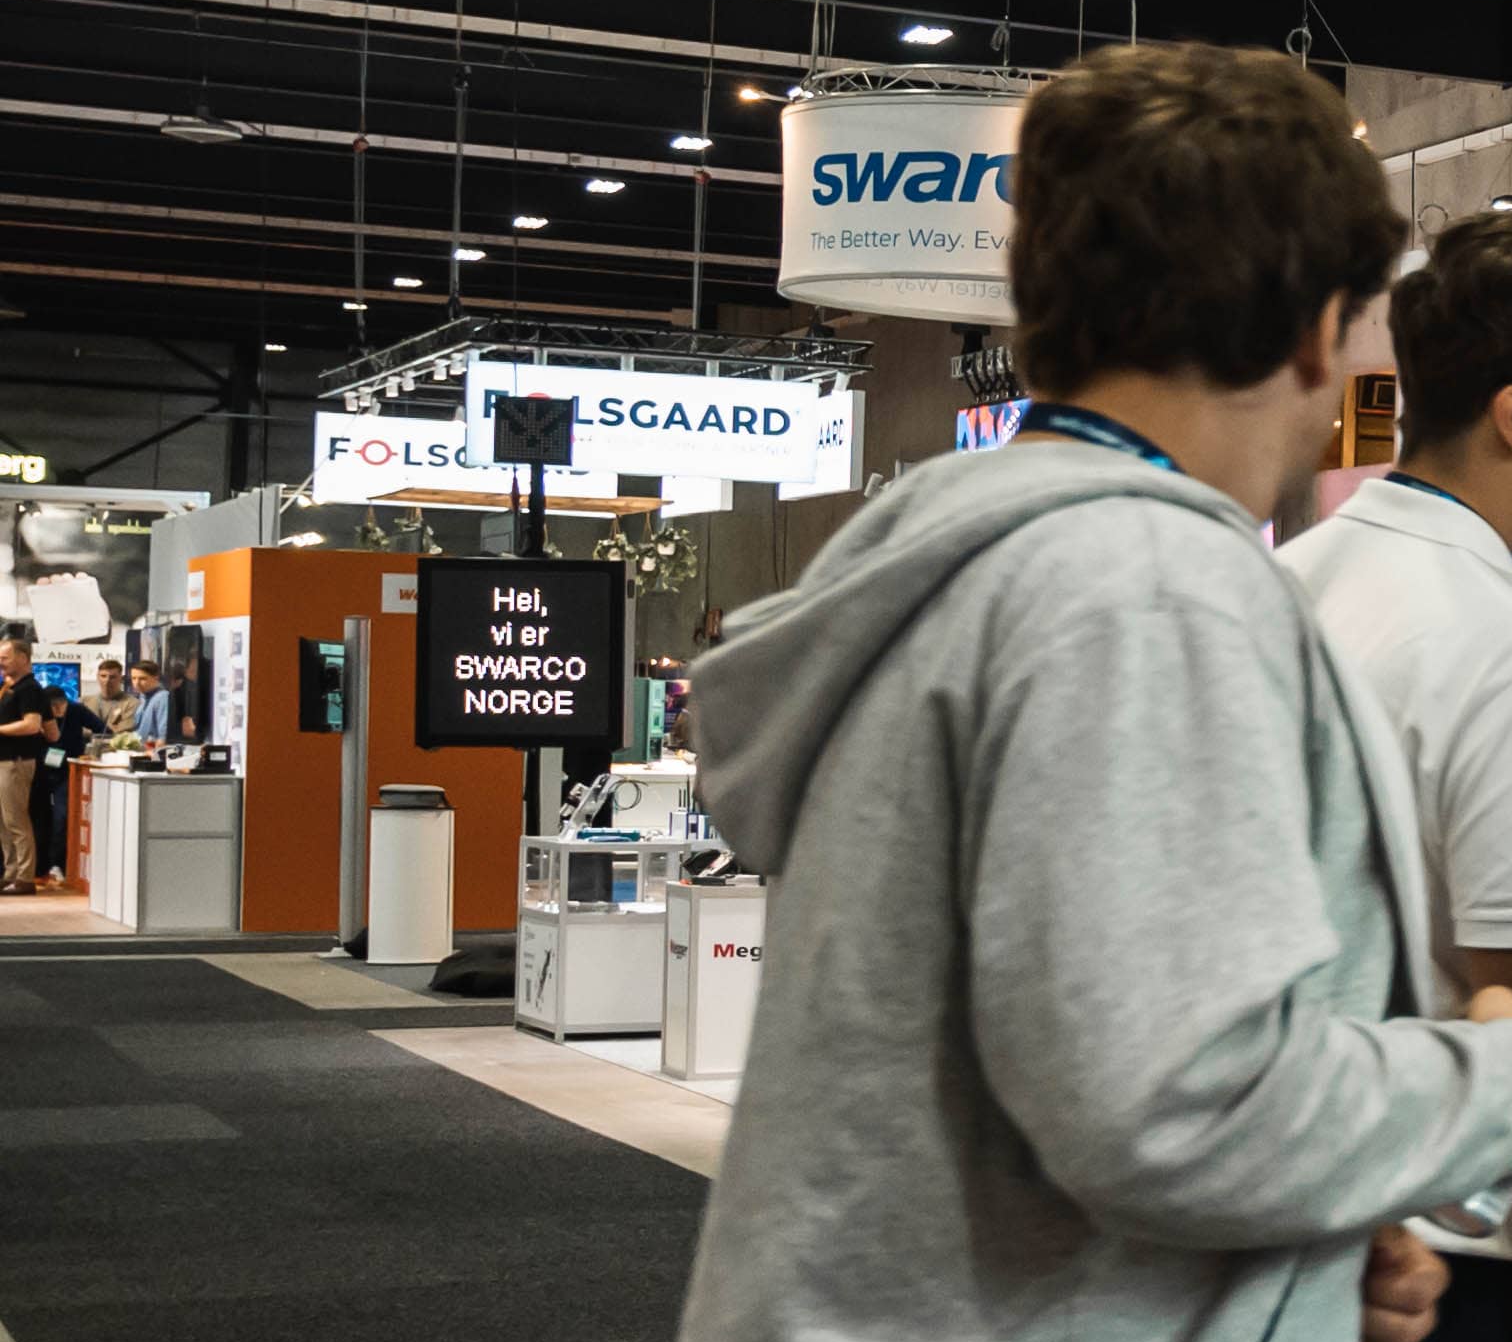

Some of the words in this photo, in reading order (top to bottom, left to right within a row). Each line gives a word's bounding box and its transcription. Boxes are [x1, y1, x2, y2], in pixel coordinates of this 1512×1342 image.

[811, 232, 835, 251] The
[841, 229, 901, 249] Better
[908, 228, 964, 253] Way.
[483, 388, 791, 436] FLSGAARD
[493, 586, 548, 618] Hei,
[490, 621, 513, 646] vi
[520, 625, 550, 647] er
[455, 655, 586, 682] SWARCO
[464, 689, 575, 715] NORGE
